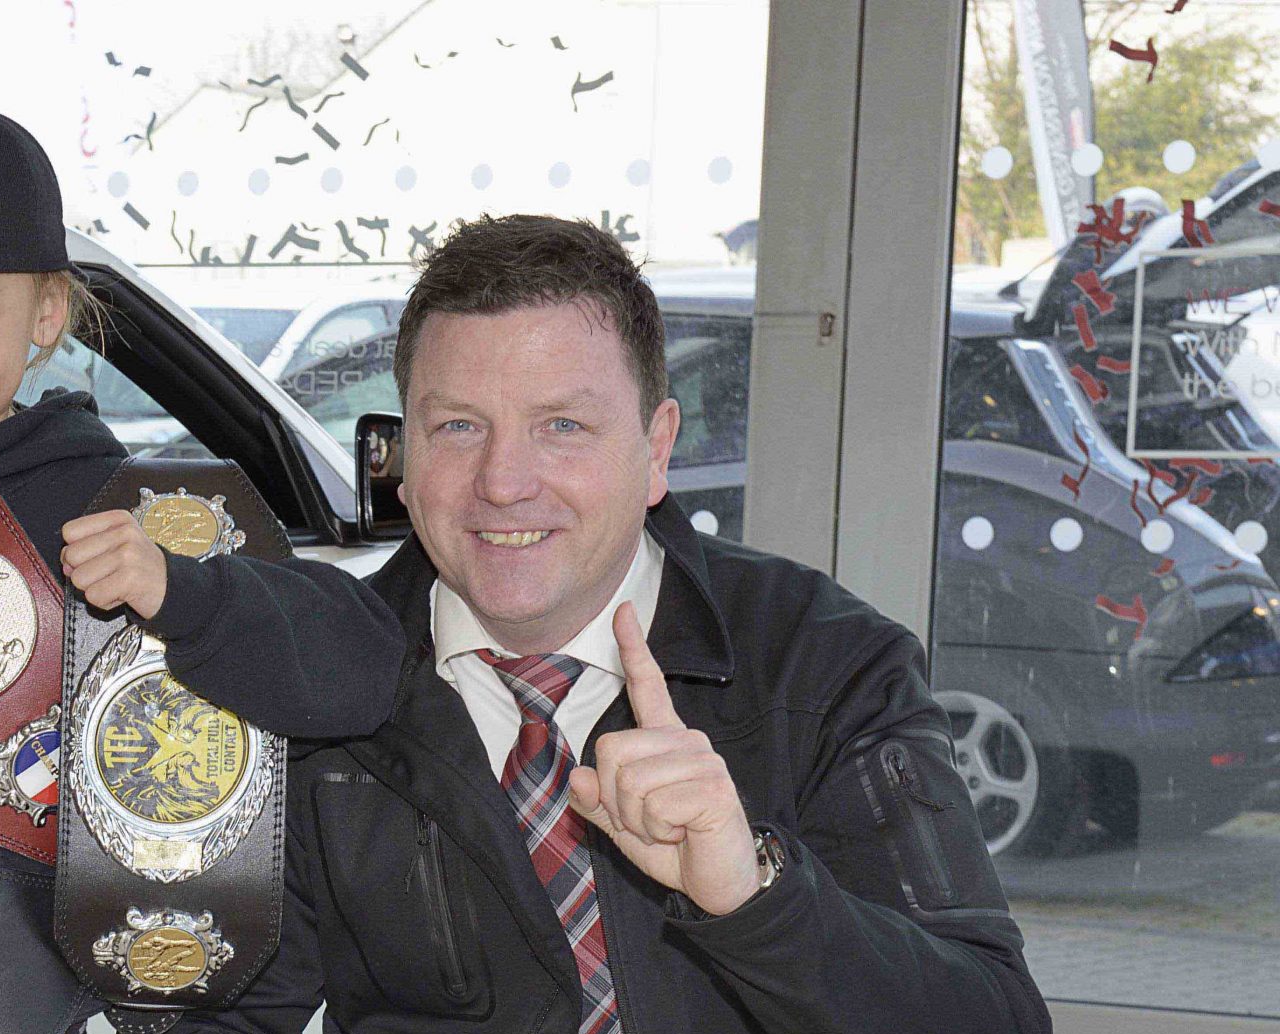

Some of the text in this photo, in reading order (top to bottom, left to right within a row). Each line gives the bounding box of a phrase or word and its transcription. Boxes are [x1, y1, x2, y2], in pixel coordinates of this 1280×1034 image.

[103, 724, 148, 769] TFC
[206, 713, 221, 779] TOTAL FULL
[223, 724, 238, 773] CONTACT
